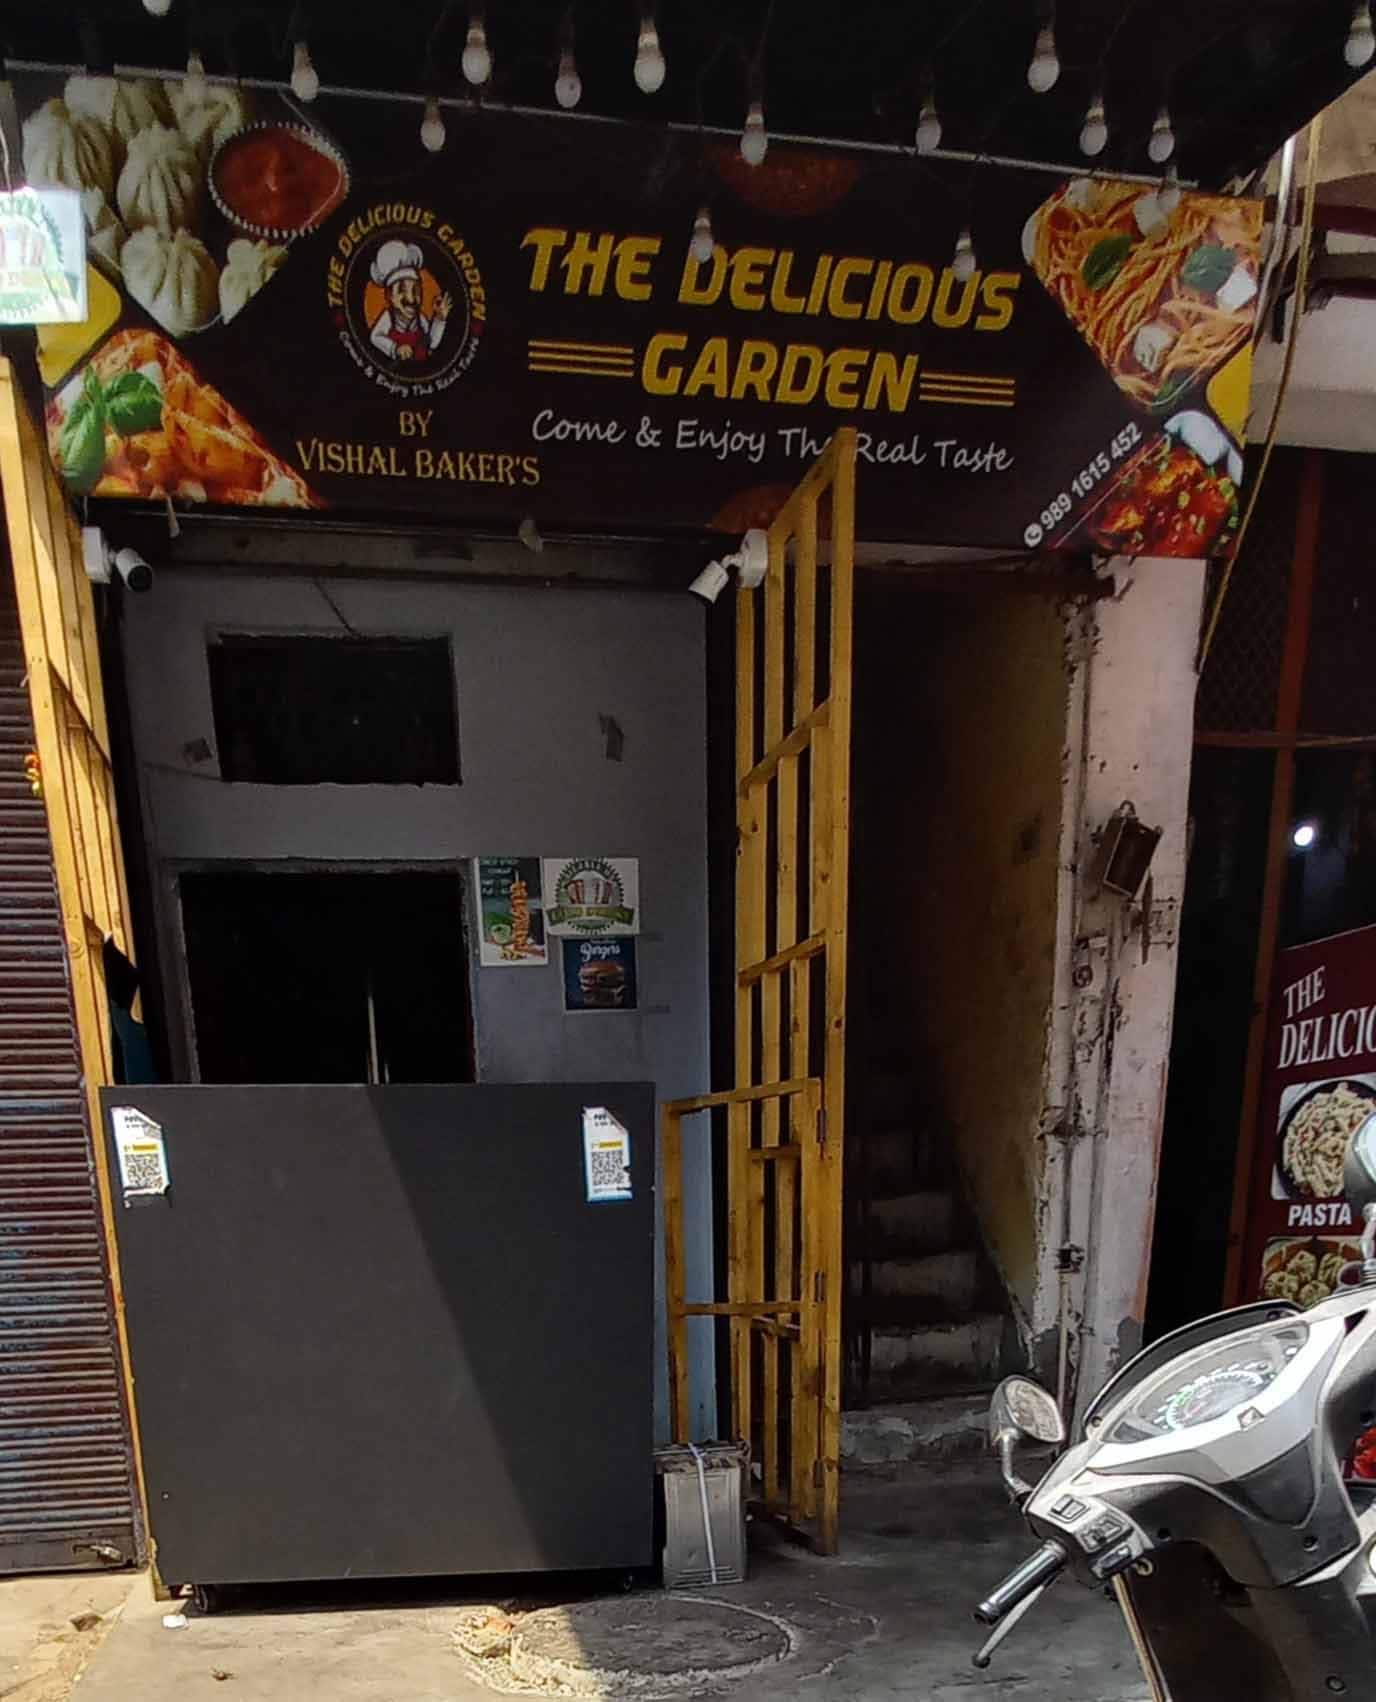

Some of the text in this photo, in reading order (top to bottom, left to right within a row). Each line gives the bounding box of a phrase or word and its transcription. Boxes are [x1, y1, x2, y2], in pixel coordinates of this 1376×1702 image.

[327, 204, 487, 321] THE DELICIOUS GARDEN
[520, 228, 1022, 331] THE DELICIOUS
[641, 333, 918, 412] GARDEN
[400, 410, 433, 437] BY
[532, 409, 1015, 472] Come & Enjoy Th Real Taste
[296, 438, 541, 486] VISHAL BAKER'S
[1041, 422, 1142, 530] 989 1615 452
[1283, 965, 1326, 1019] THE
[1288, 1202, 1352, 1227] PASTA
